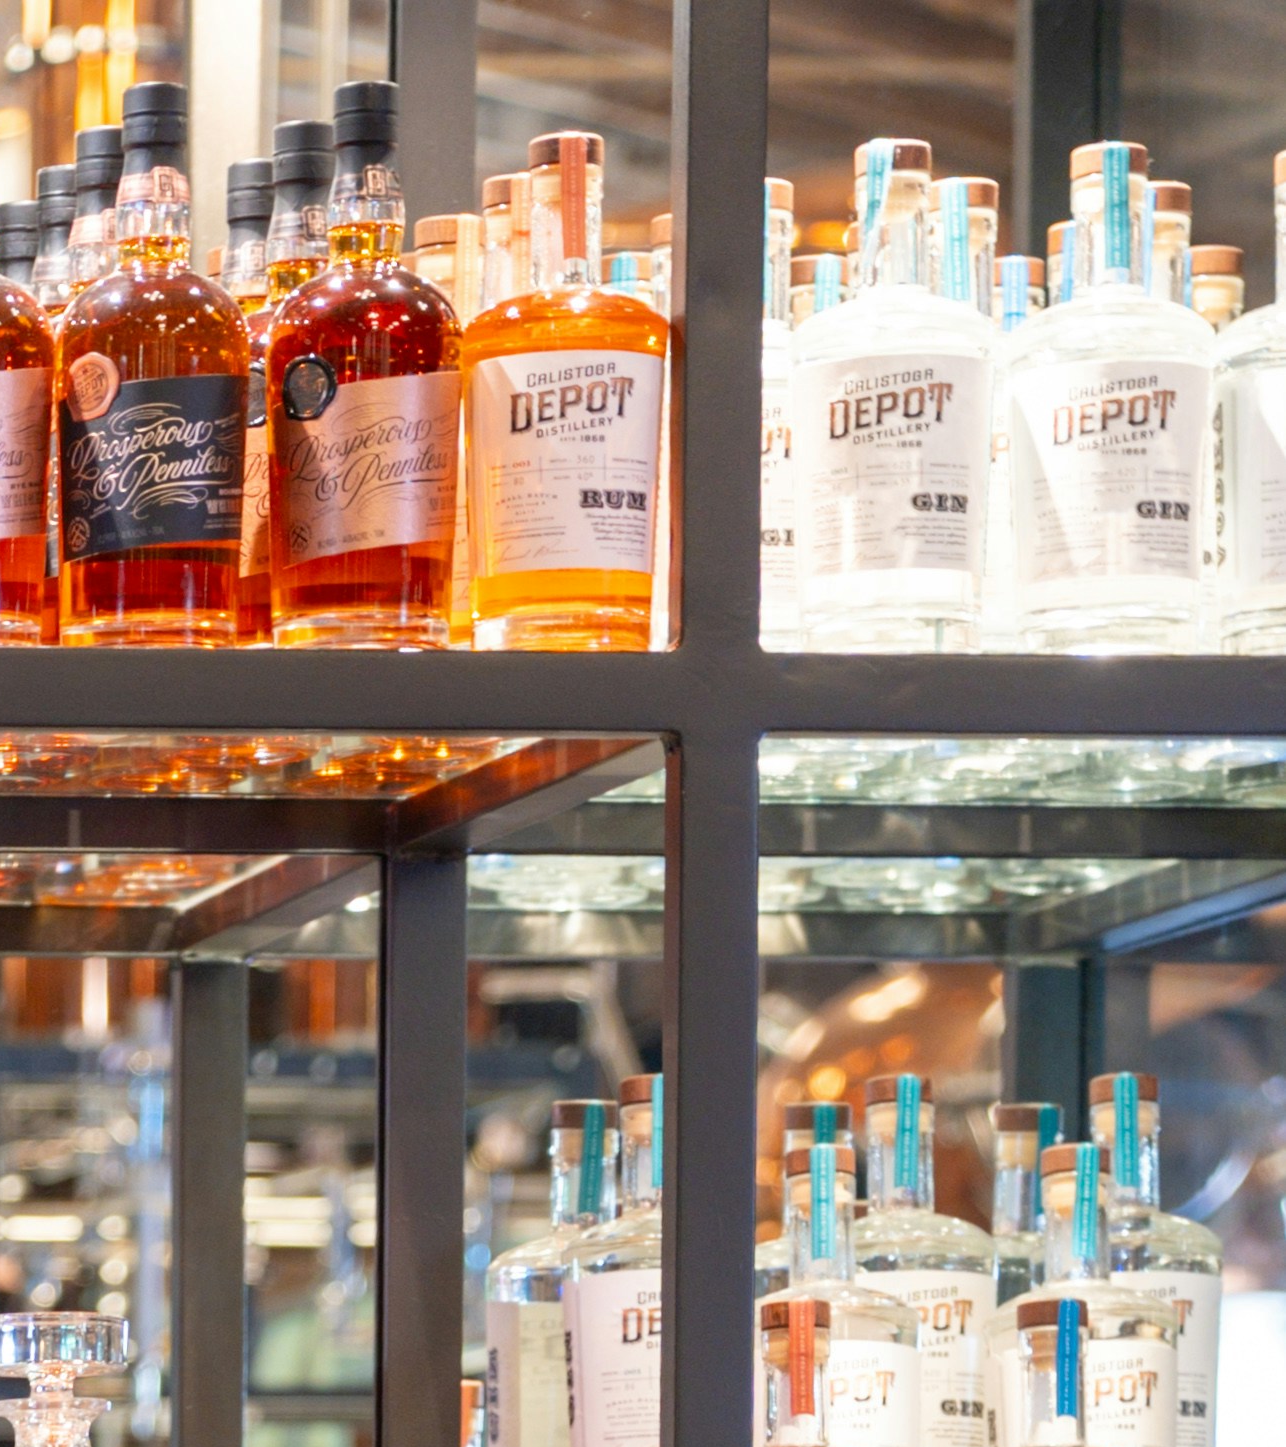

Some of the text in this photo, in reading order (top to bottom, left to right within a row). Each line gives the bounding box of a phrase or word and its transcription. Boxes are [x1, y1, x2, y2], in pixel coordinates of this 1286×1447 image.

[527, 362, 616, 387] CALISTOGA
[844, 368, 934, 395] CALISTOGA
[1069, 375, 1159, 401] CALISTOGA
[509, 376, 634, 434] DEPOT
[830, 382, 953, 440] DEPOT
[1053, 389, 1176, 446] DEPOT
[536, 417, 614, 438] DISTILLERY
[580, 434, 606, 443] 1868
[853, 422, 932, 445] DISTILLERY
[1078, 429, 1156, 451] DISTILLERY
[71, 416, 213, 480] Prosperous
[289, 416, 433, 482] Prosperous
[93, 464, 121, 500] &
[118, 446, 237, 510] Penniless
[315, 444, 451, 510] & Penniless
[579, 489, 647, 511] RUM
[912, 492, 968, 513] GIN
[1137, 501, 1190, 521] GIN
[941, 1399, 984, 1418] GIN
